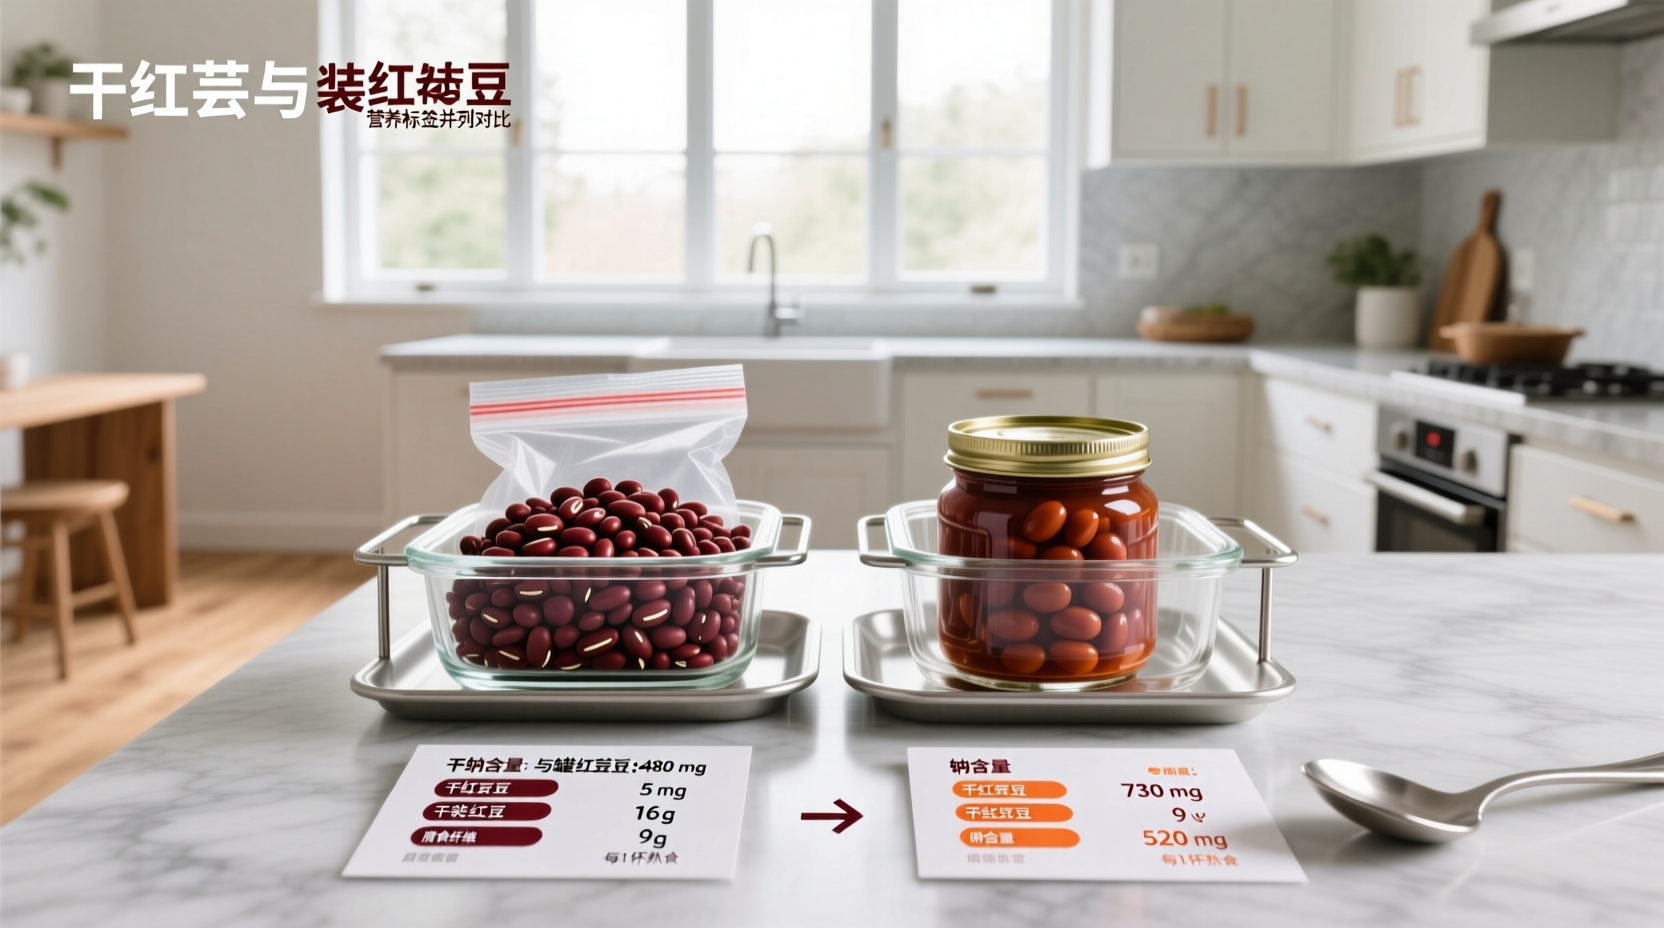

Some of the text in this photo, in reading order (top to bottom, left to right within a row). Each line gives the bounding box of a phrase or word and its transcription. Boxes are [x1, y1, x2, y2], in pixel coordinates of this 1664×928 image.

[679, 764, 707, 776] mg
[639, 783, 687, 800] 5 mg
[1121, 783, 1203, 802] 730 mg
[1143, 830, 1228, 850] 520 mg
